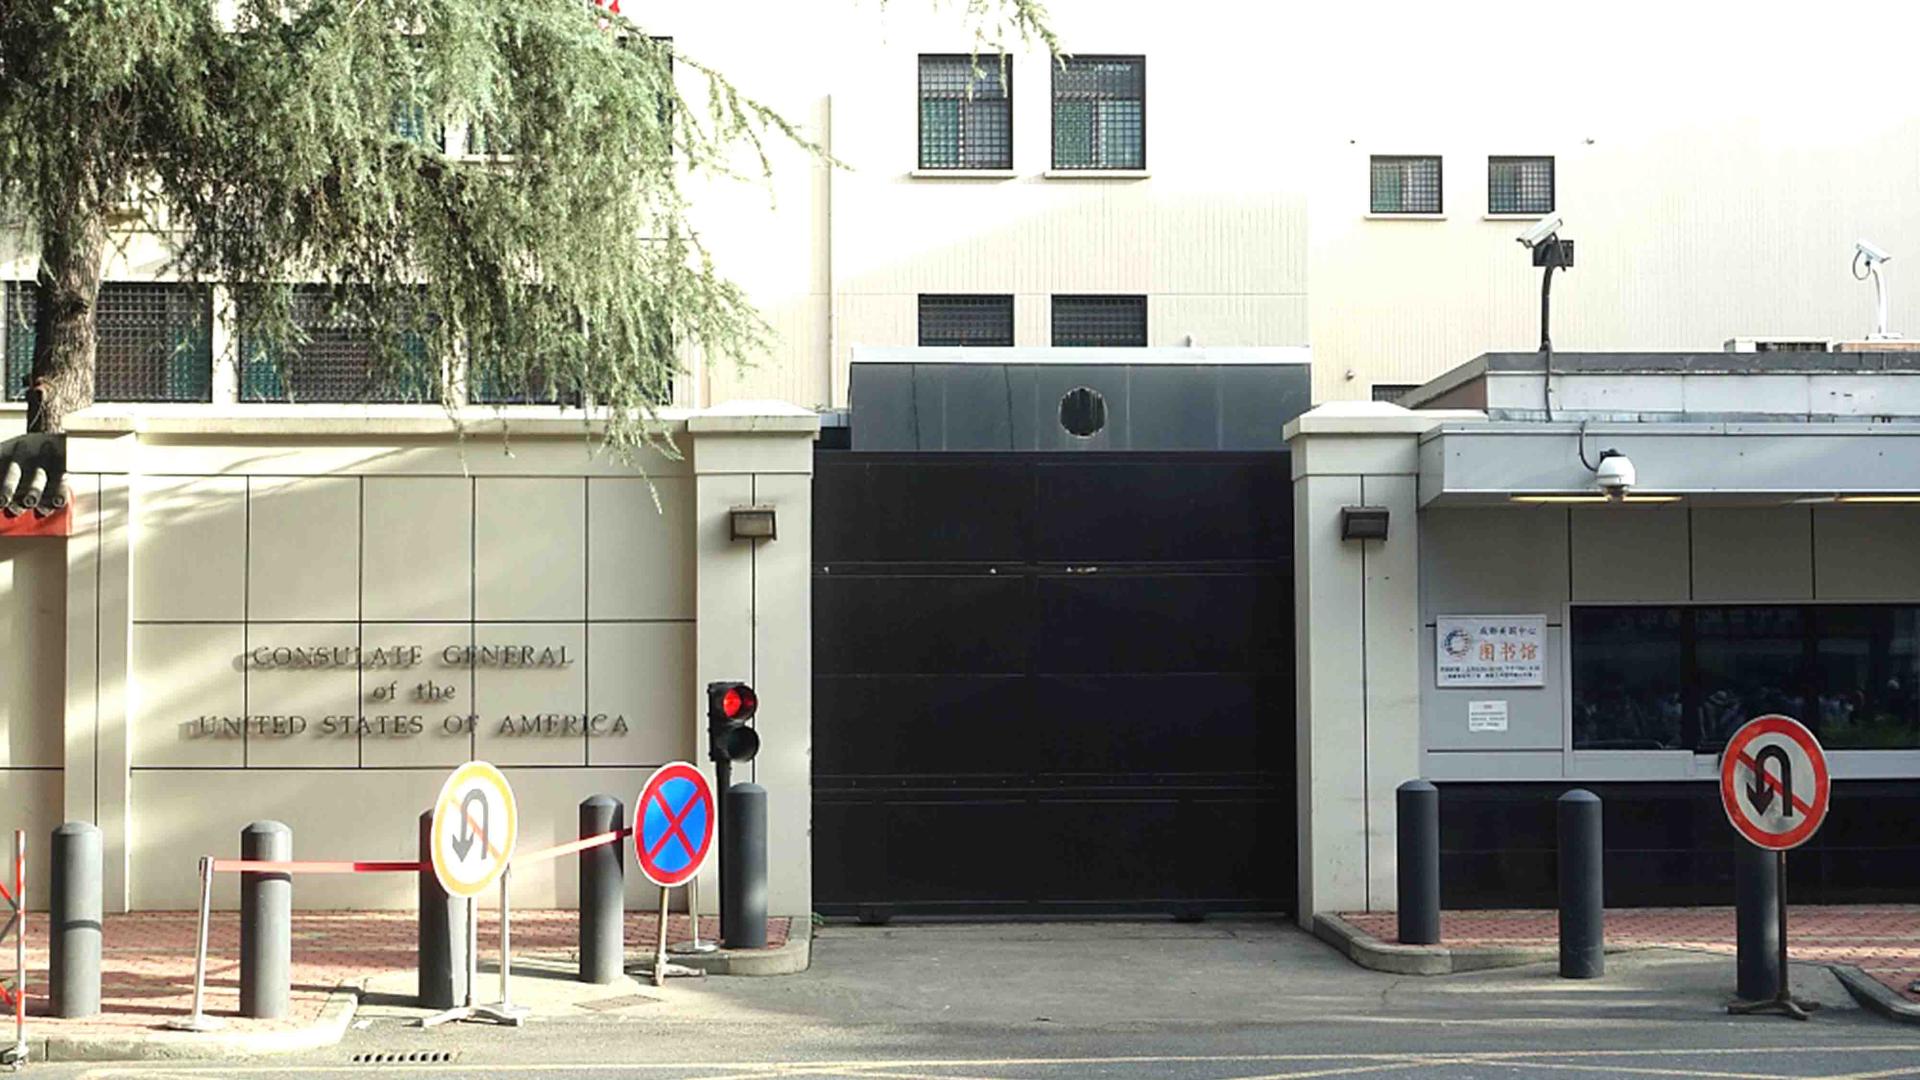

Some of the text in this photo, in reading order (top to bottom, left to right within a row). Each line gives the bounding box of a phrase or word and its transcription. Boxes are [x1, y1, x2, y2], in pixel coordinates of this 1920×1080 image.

[254, 645, 574, 666] CONSULATE GENERAL
[1479, 640, 1538, 662] 图书馆
[373, 679, 456, 700] of the
[199, 714, 629, 735] UNITED STATES OF AMERICA
